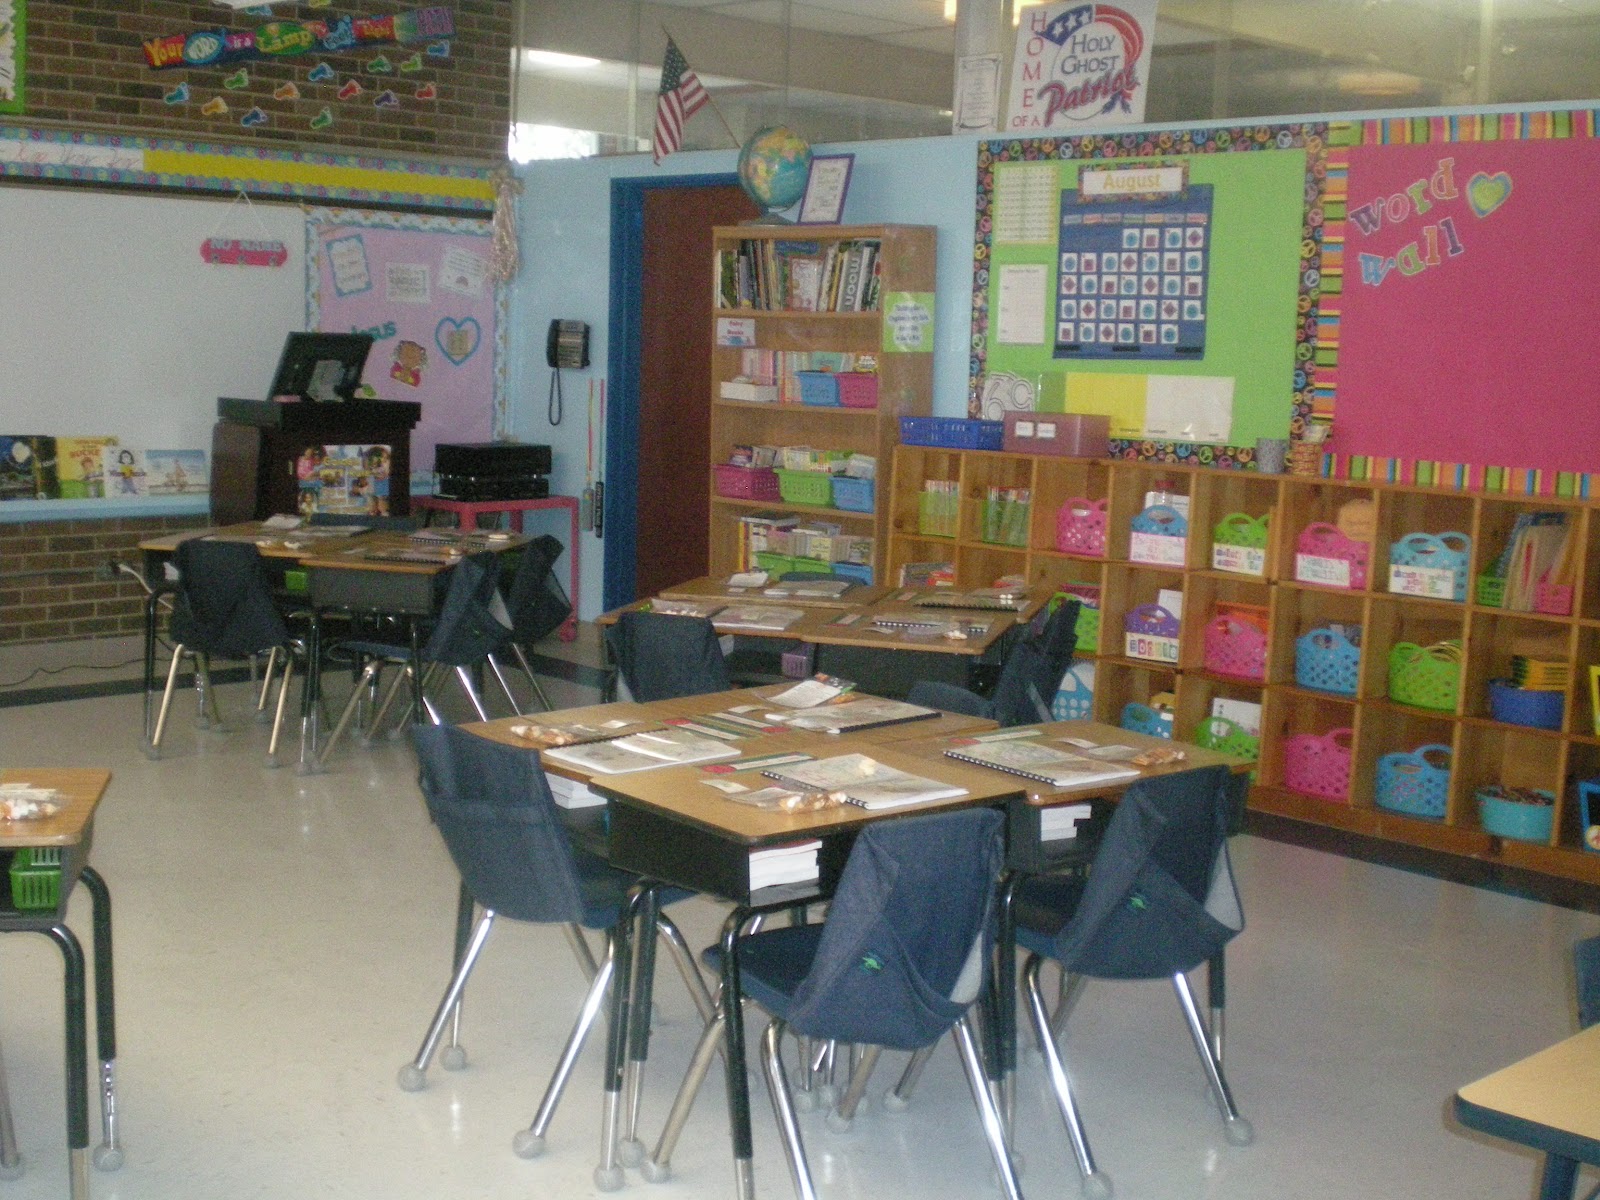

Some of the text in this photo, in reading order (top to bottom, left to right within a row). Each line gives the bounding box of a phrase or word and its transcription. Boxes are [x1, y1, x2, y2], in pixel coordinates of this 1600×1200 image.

[256, 31, 313, 53] Lamp
[1022, 11, 1047, 108] HOME
[1012, 115, 1040, 128] OF A
[1103, 174, 1162, 191] August
[1349, 157, 1459, 235] word
[1358, 216, 1465, 287] wall
